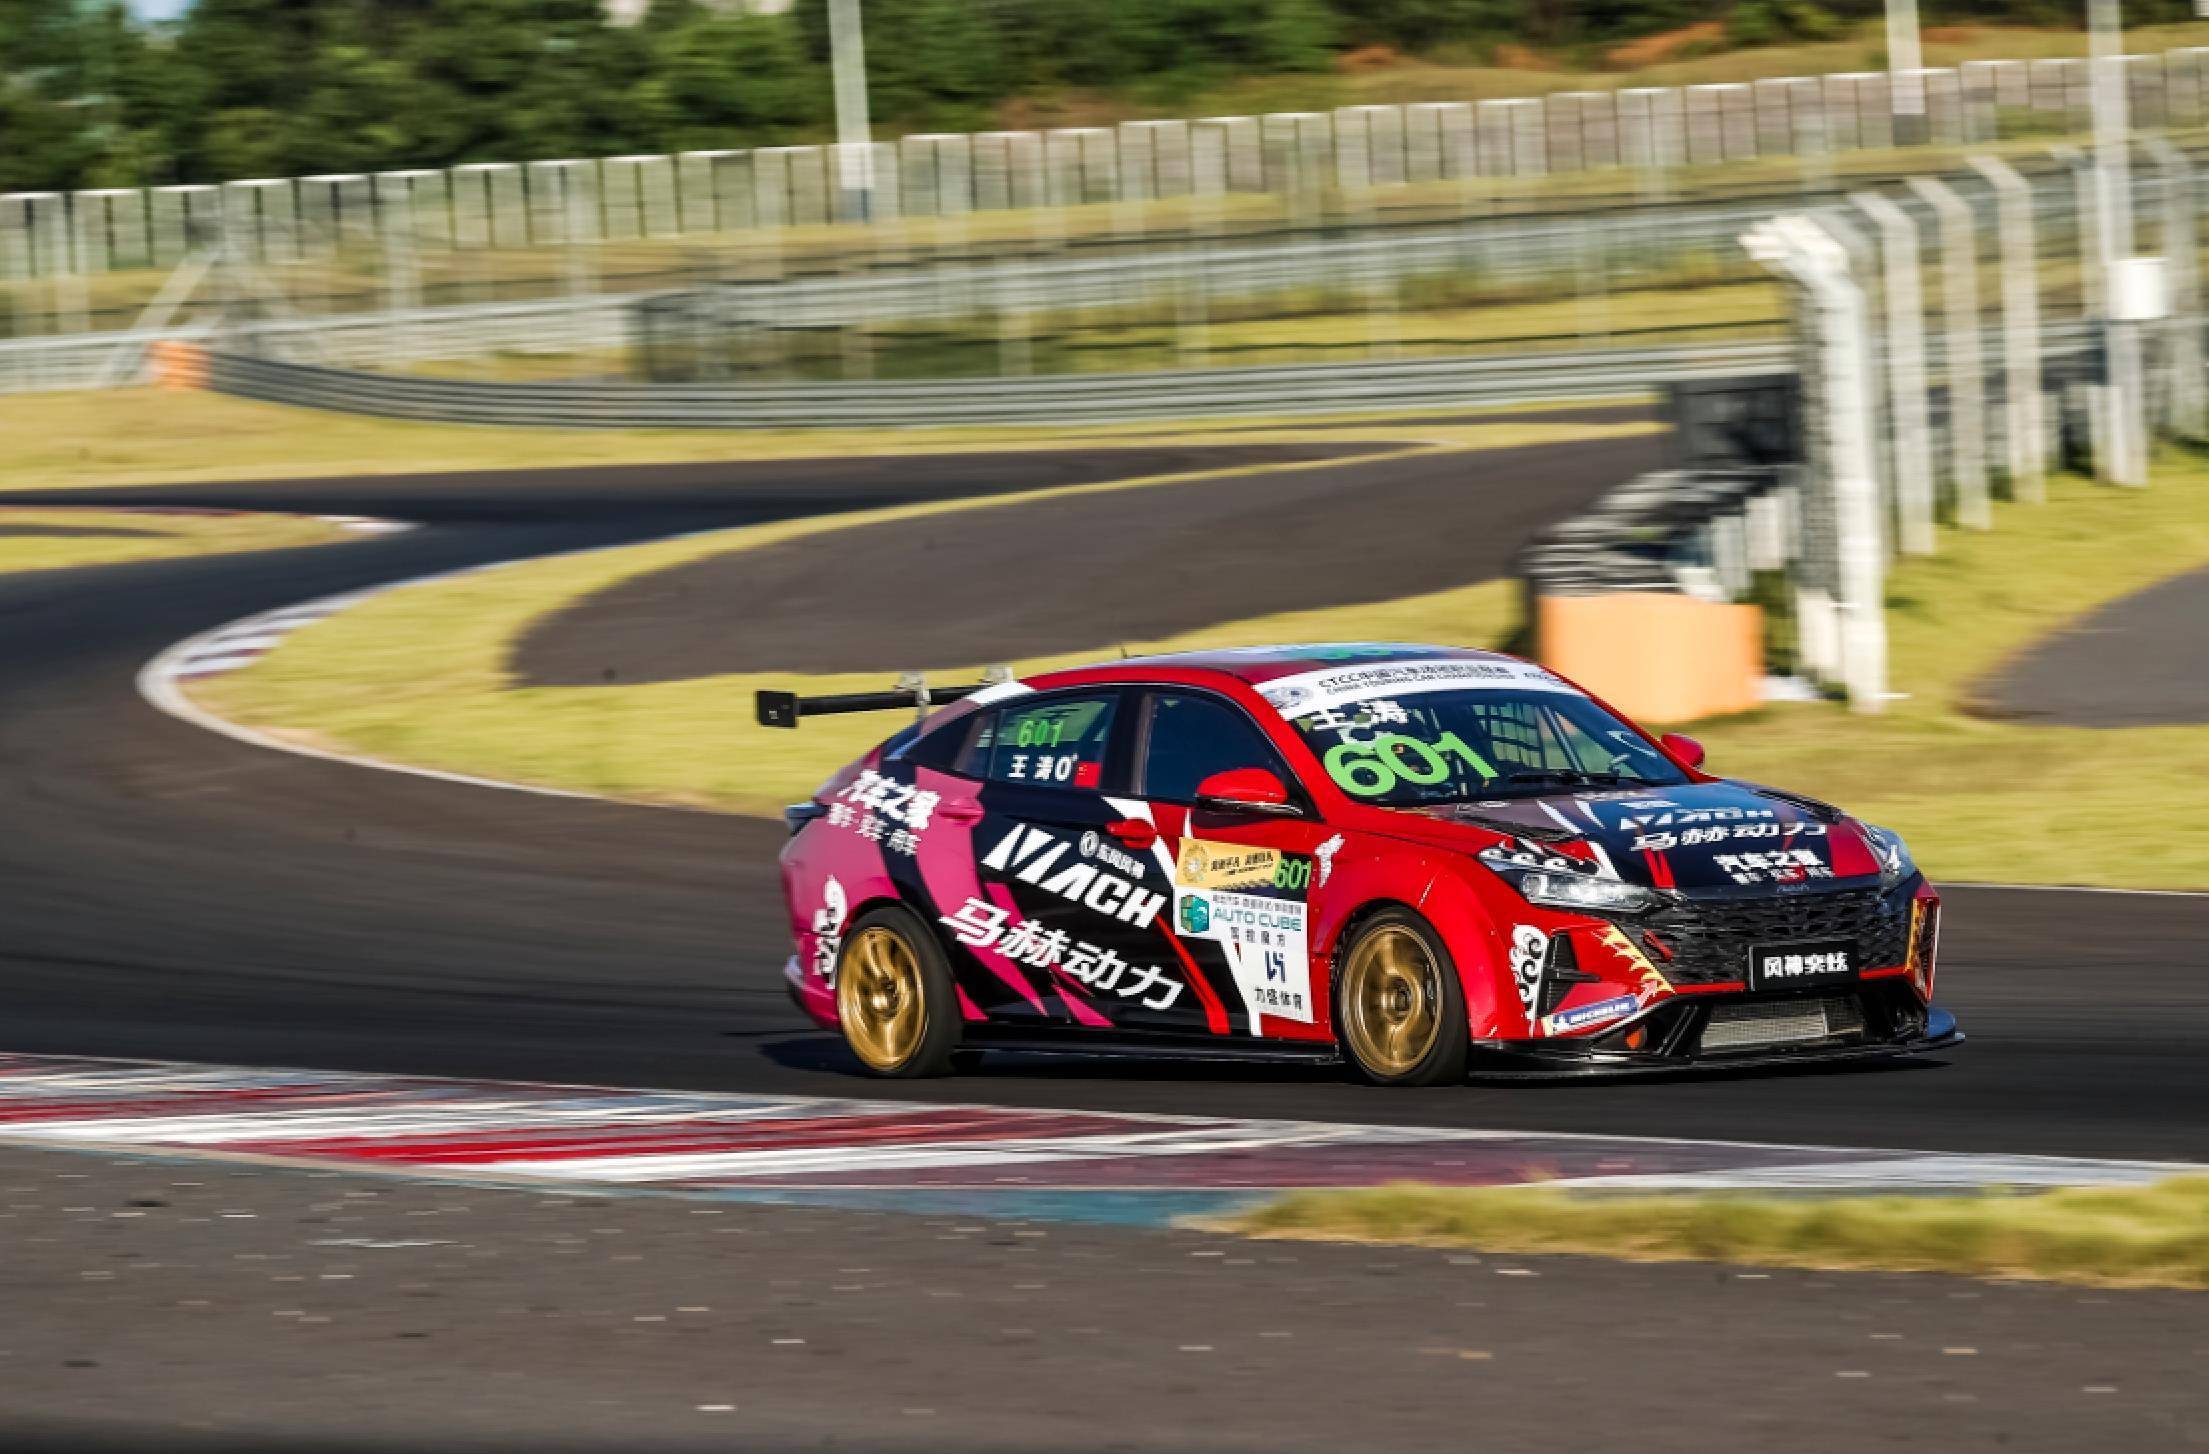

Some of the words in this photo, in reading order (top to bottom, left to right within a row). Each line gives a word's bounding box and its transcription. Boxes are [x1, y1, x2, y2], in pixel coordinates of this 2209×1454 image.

[1018, 720, 1064, 748] 601
[1323, 730, 1499, 796] 601
[1630, 821, 1827, 852] 马赫动力
[1273, 858, 1312, 890] 601
[1212, 905, 1256, 924] AUTO
[1259, 912, 1302, 931] CUBE
[939, 896, 1184, 1010] 马赫动力
